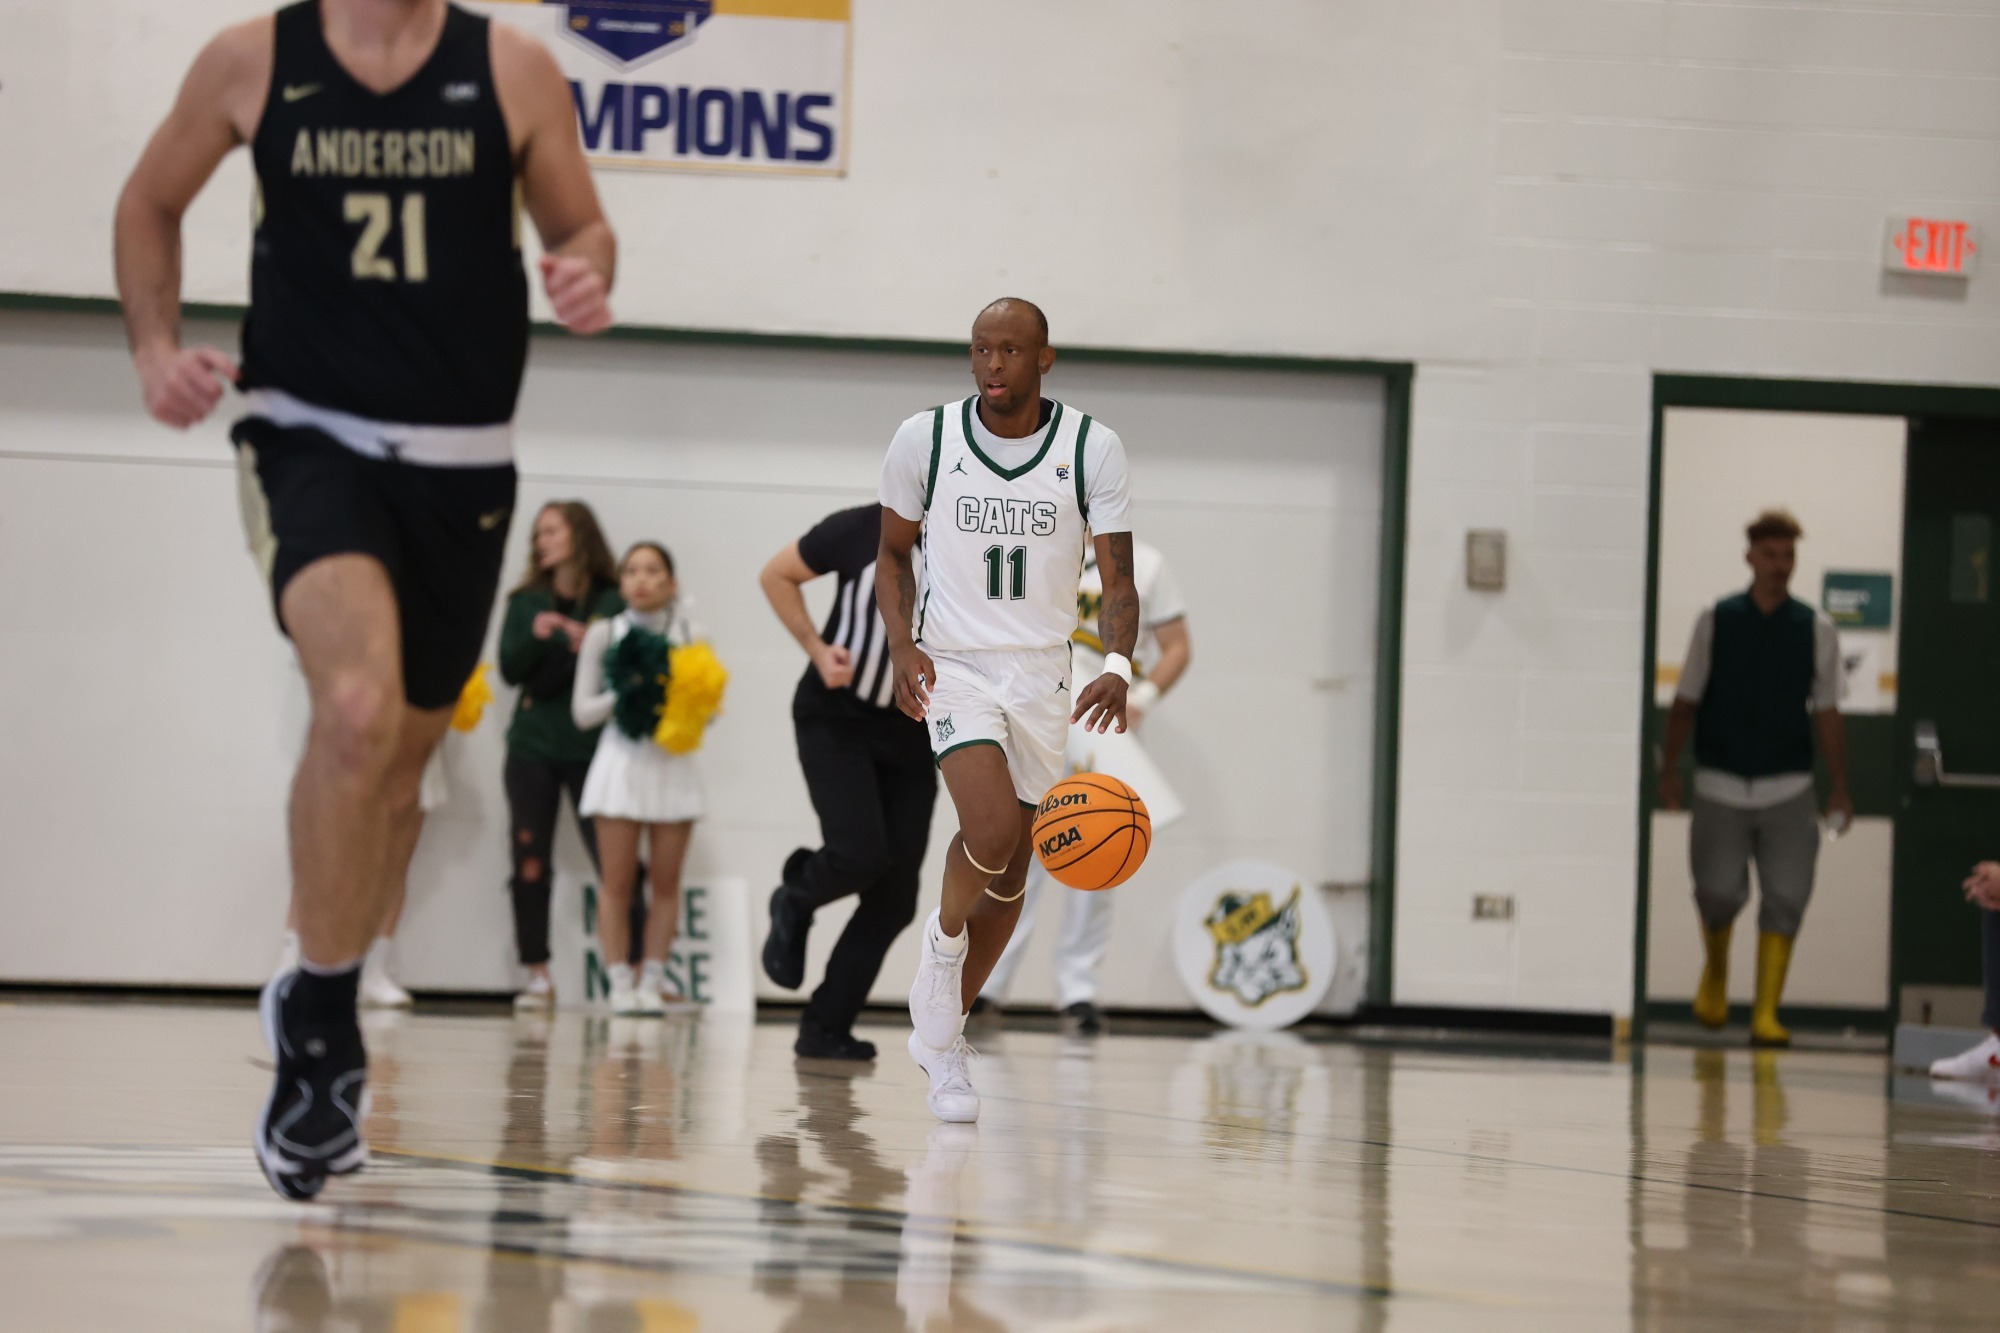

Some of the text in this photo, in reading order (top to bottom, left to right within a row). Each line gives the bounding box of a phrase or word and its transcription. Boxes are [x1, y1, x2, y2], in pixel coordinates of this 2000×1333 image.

[565, 81, 835, 162] MPIONS
[291, 128, 475, 177] ANDERSON
[343, 193, 428, 282] 21
[1905, 217, 1968, 272] EXIT
[956, 496, 1056, 536] CATS
[984, 545, 1027, 600] 11
[1039, 826, 1082, 858] NCAA
[583, 948, 712, 1003] NSE
